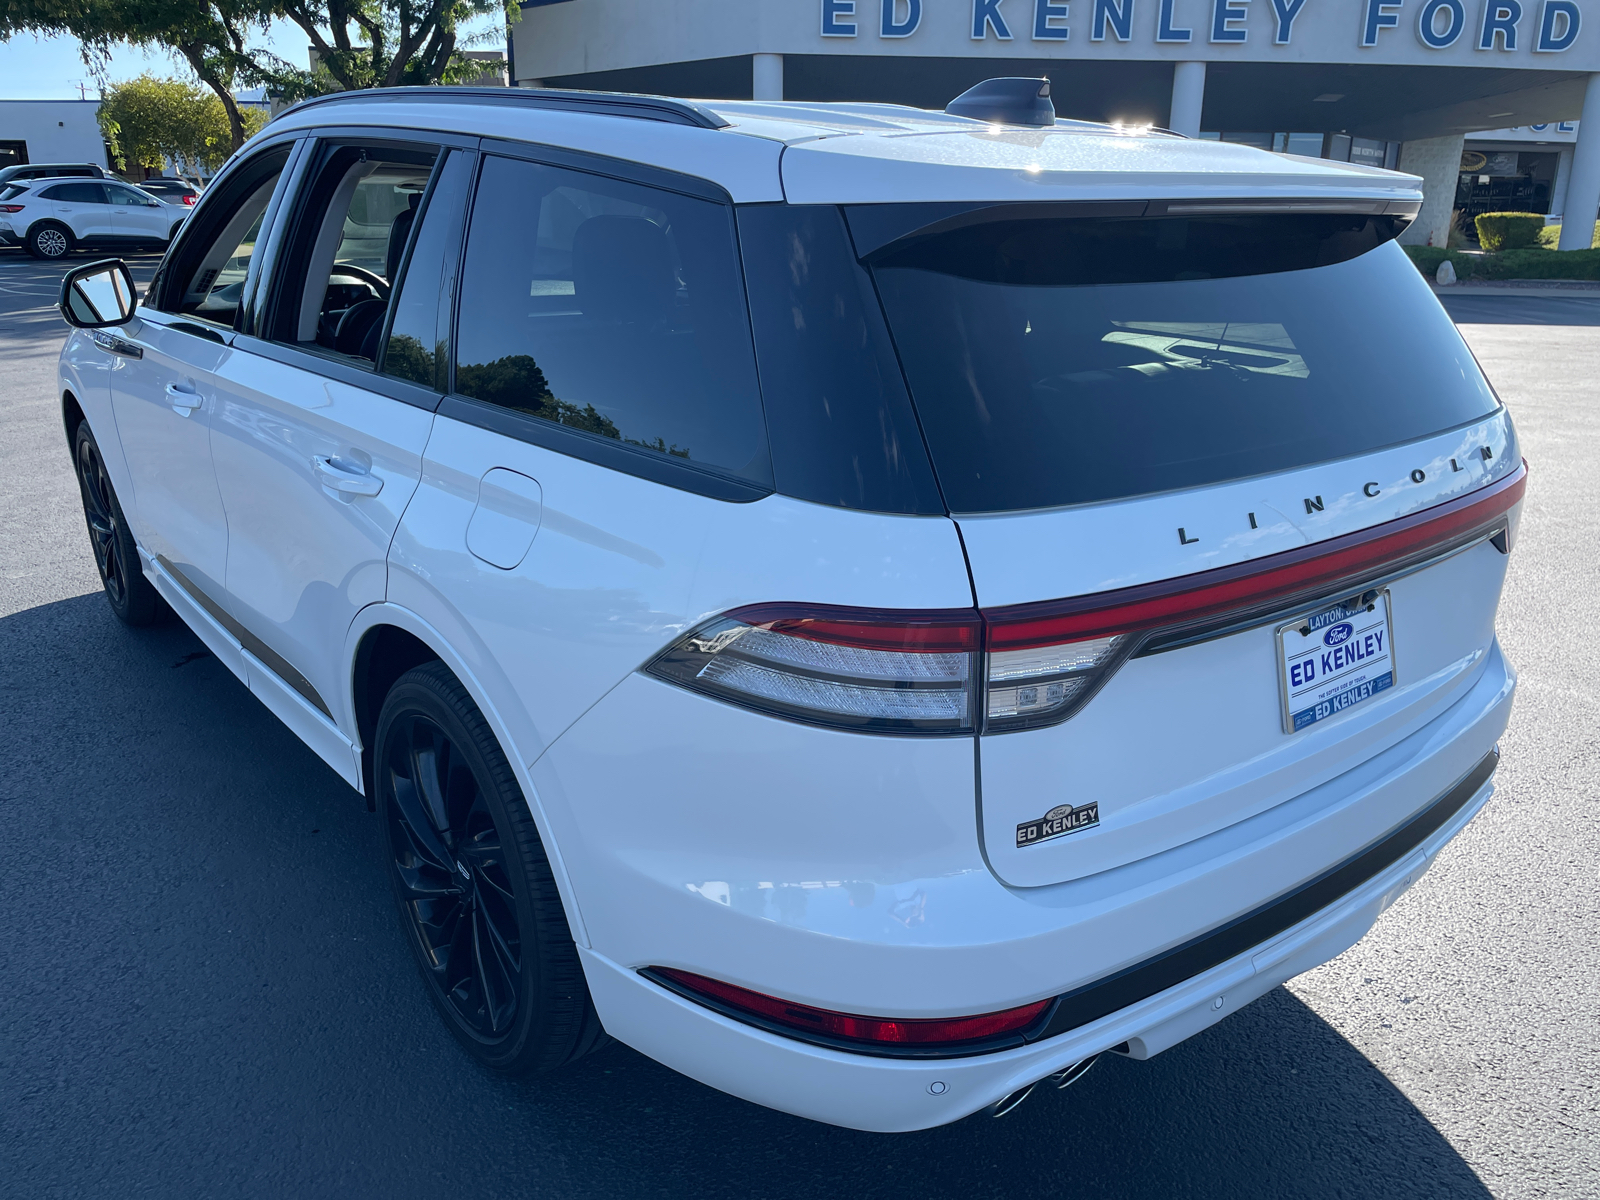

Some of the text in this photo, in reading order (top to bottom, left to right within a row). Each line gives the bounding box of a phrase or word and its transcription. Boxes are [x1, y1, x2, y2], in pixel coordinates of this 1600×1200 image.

[820, 0, 1583, 53] ED KENLEY FORD
[1178, 446, 1493, 545] LINCOLN
[1310, 607, 1344, 630] LAYTON,
[1328, 626, 1349, 645] Ford
[1290, 630, 1384, 687] ED KENLEY
[1315, 704, 1330, 720] ED
[1333, 681, 1374, 711] KENLEY
[1018, 807, 1097, 842] ED KENLEY
